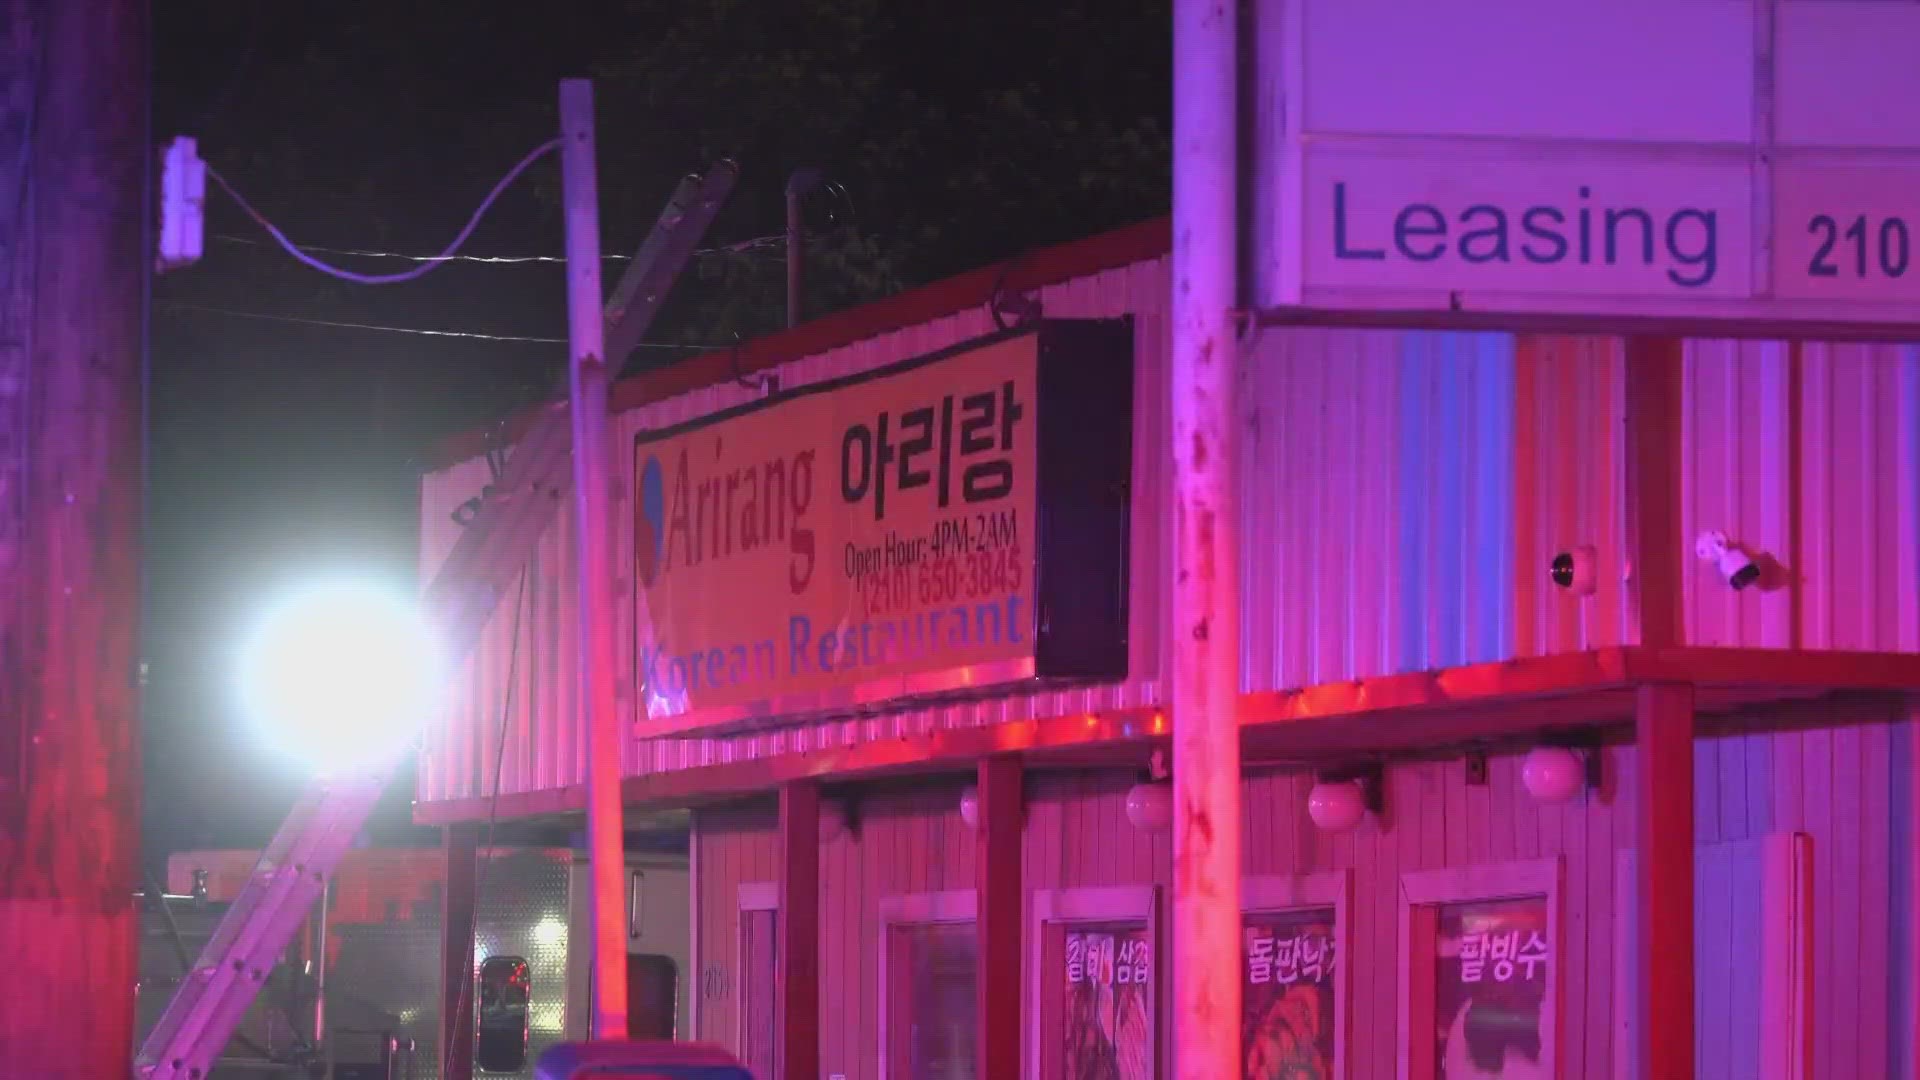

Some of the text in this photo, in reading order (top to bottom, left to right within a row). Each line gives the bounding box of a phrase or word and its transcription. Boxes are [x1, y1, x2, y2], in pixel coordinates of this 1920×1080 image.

[1333, 181, 1719, 287] Leasing
[1807, 213, 1909, 279] 210
[840, 380, 1023, 521] 아리랑
[665, 437, 816, 596] Arirang
[844, 507, 1018, 593] Open Hour: 4PM-2AM
[917, 546, 1023, 607] 650-3845
[641, 595, 1024, 704] Korean Restaurant
[1460, 930, 1547, 982] 팥빙수
